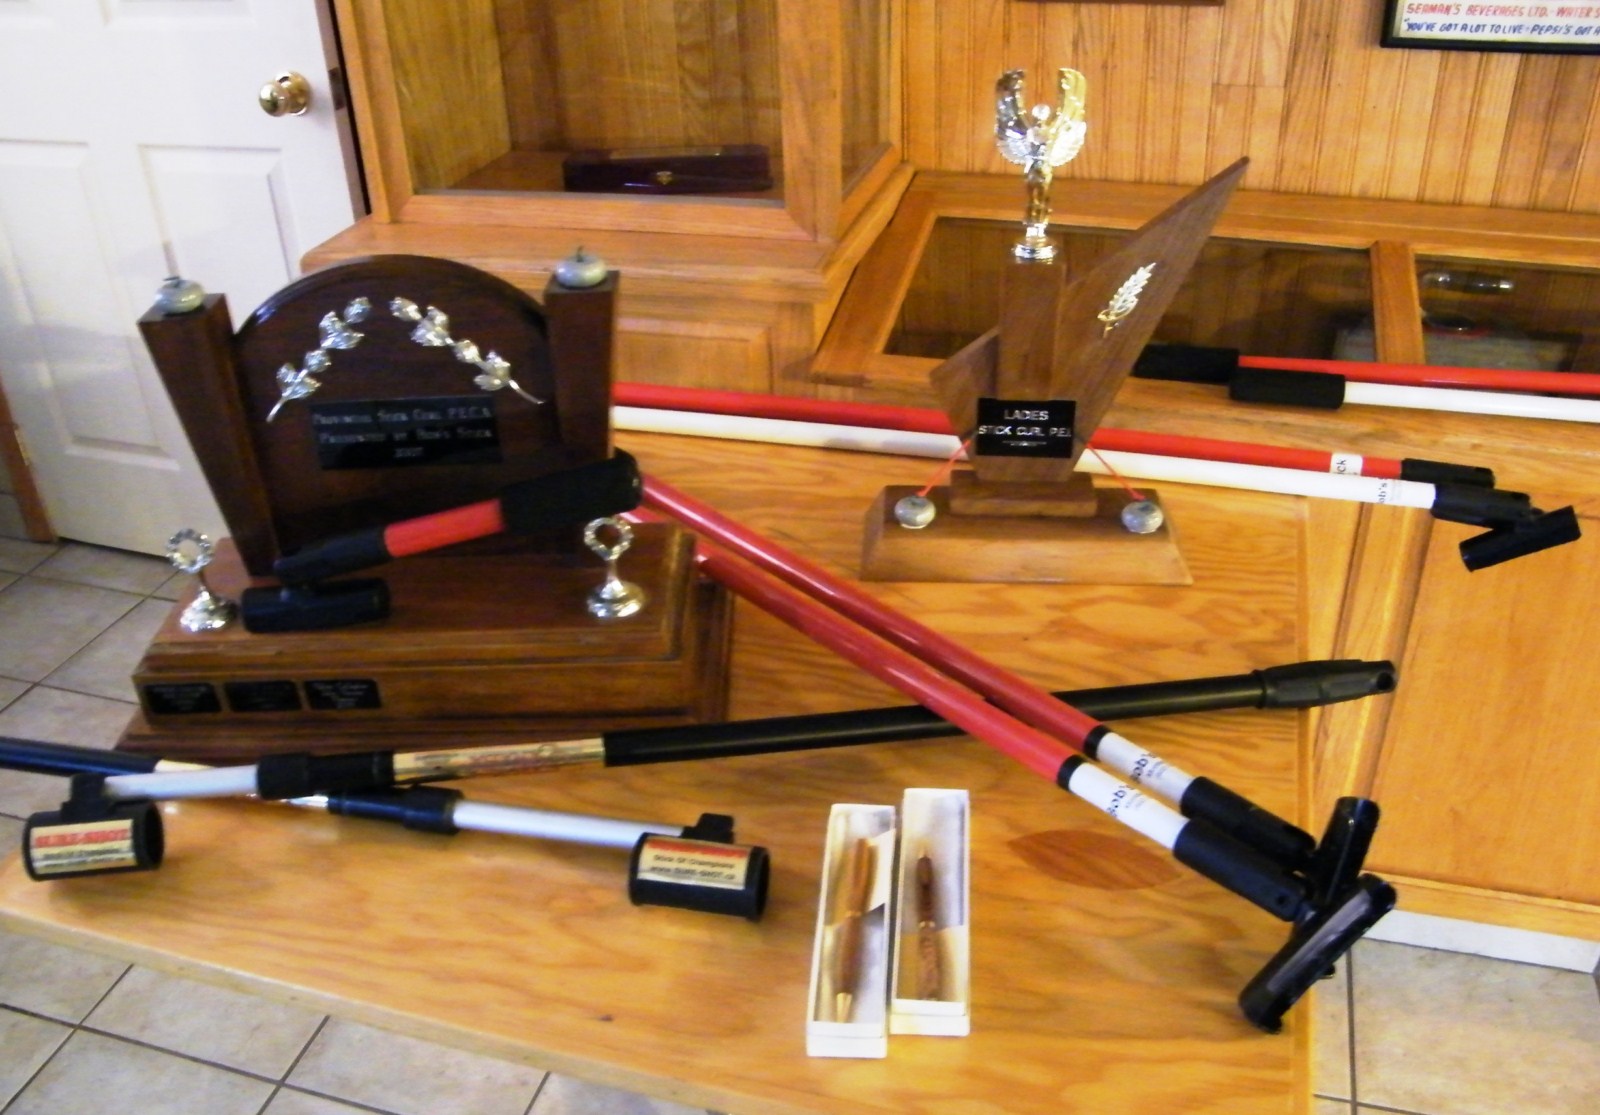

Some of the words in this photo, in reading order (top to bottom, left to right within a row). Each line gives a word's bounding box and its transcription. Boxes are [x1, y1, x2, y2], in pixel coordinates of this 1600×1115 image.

[1406, 3, 1460, 16] SEAMAN'S
[1466, 5, 1525, 17] BEVERAGES
[1439, 23, 1458, 33] GOT
[1469, 23, 1486, 33] LOT
[1490, 24, 1502, 34] TO
[1502, 24, 1523, 34] LIVE
[1530, 24, 1570, 35] PEPSI'S
[1575, 25, 1593, 36] GOT
